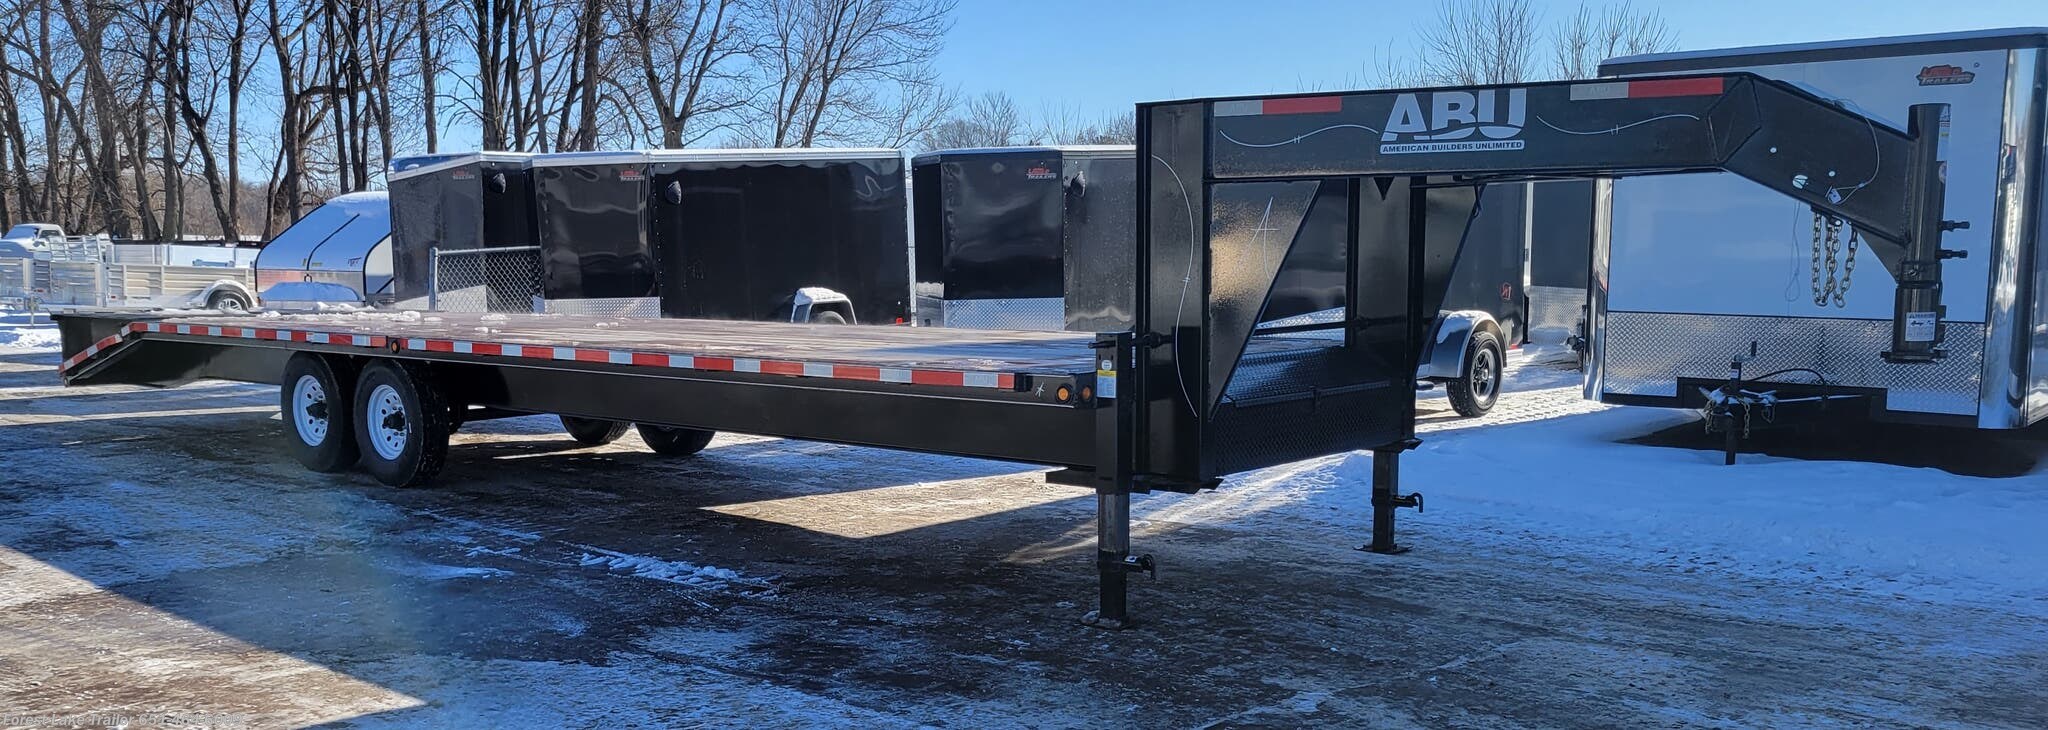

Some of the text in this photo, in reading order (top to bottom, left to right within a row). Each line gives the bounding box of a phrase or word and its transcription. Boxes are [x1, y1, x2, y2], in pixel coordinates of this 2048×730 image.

[1381, 88, 1527, 142] ABU
[1382, 141, 1522, 153] AMERICAN BUILDERS UNLIMITED
